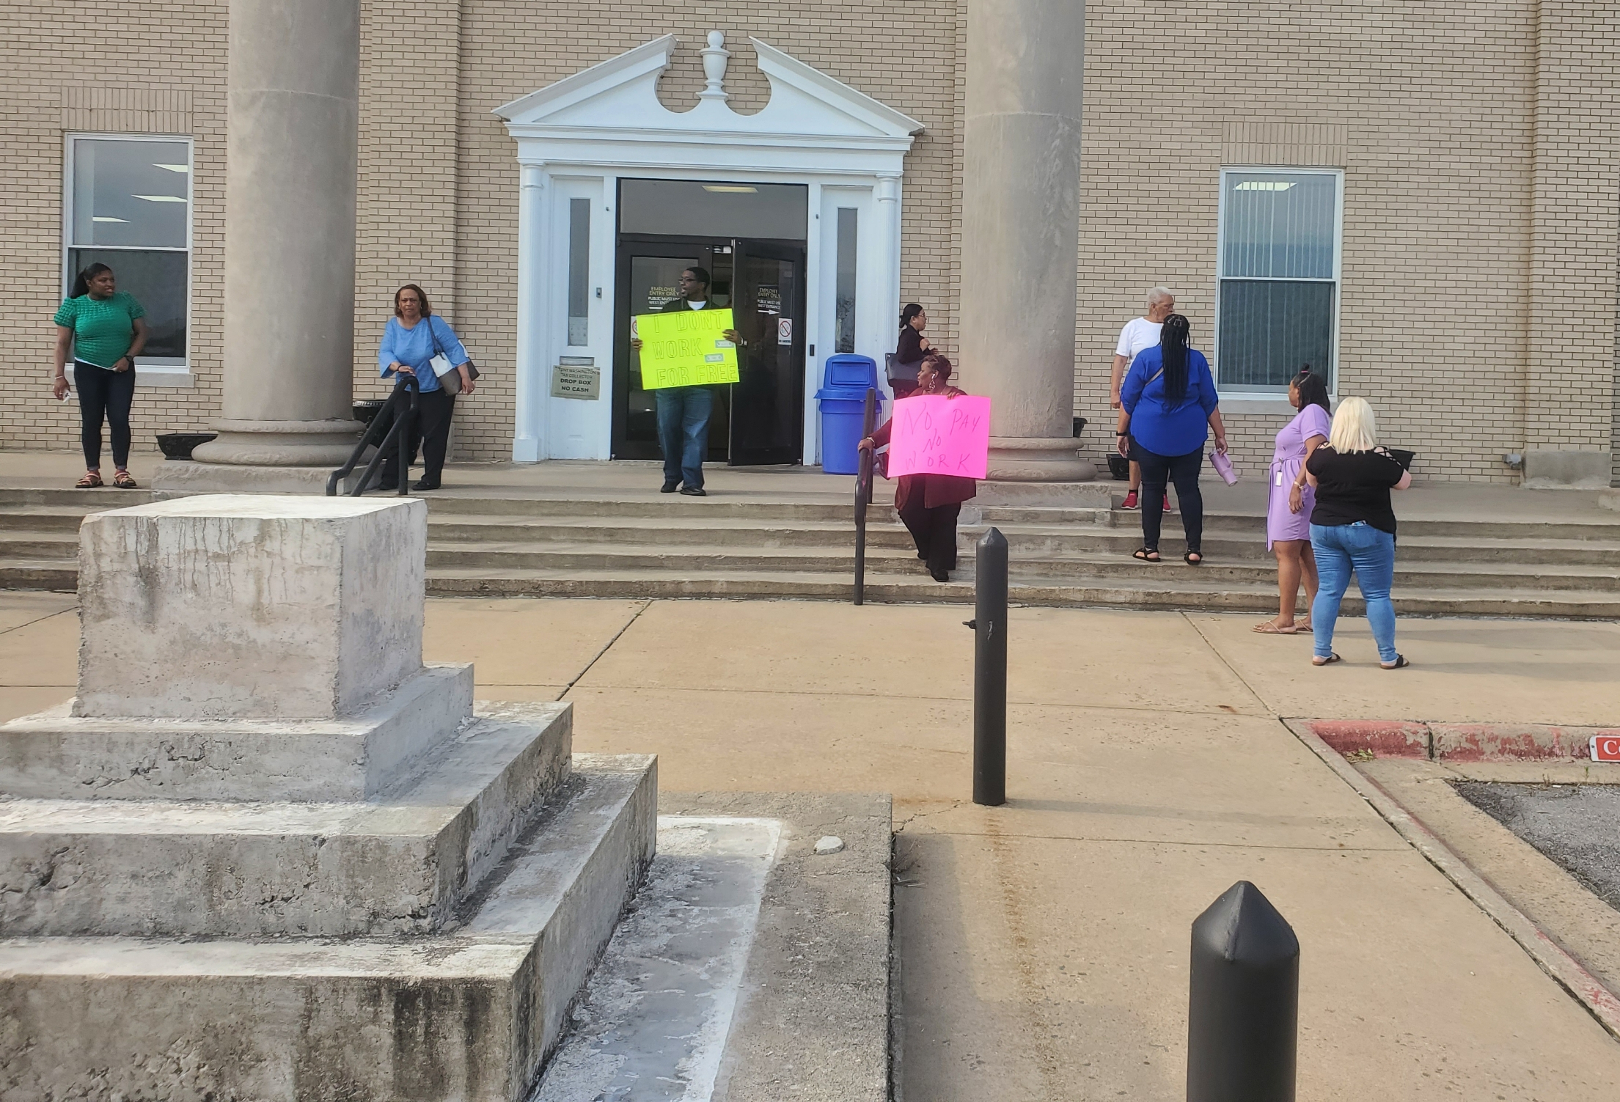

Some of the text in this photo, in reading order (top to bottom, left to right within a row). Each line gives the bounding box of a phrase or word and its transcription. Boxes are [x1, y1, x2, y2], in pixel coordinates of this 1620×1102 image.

[653, 311, 723, 334] I DONT
[652, 338, 703, 360] WORK
[656, 363, 738, 387] FOR FREE
[950, 408, 981, 436] PAY
[923, 428, 941, 453] NO
[905, 450, 971, 473] WORK
[1603, 740, 1620, 756] C
